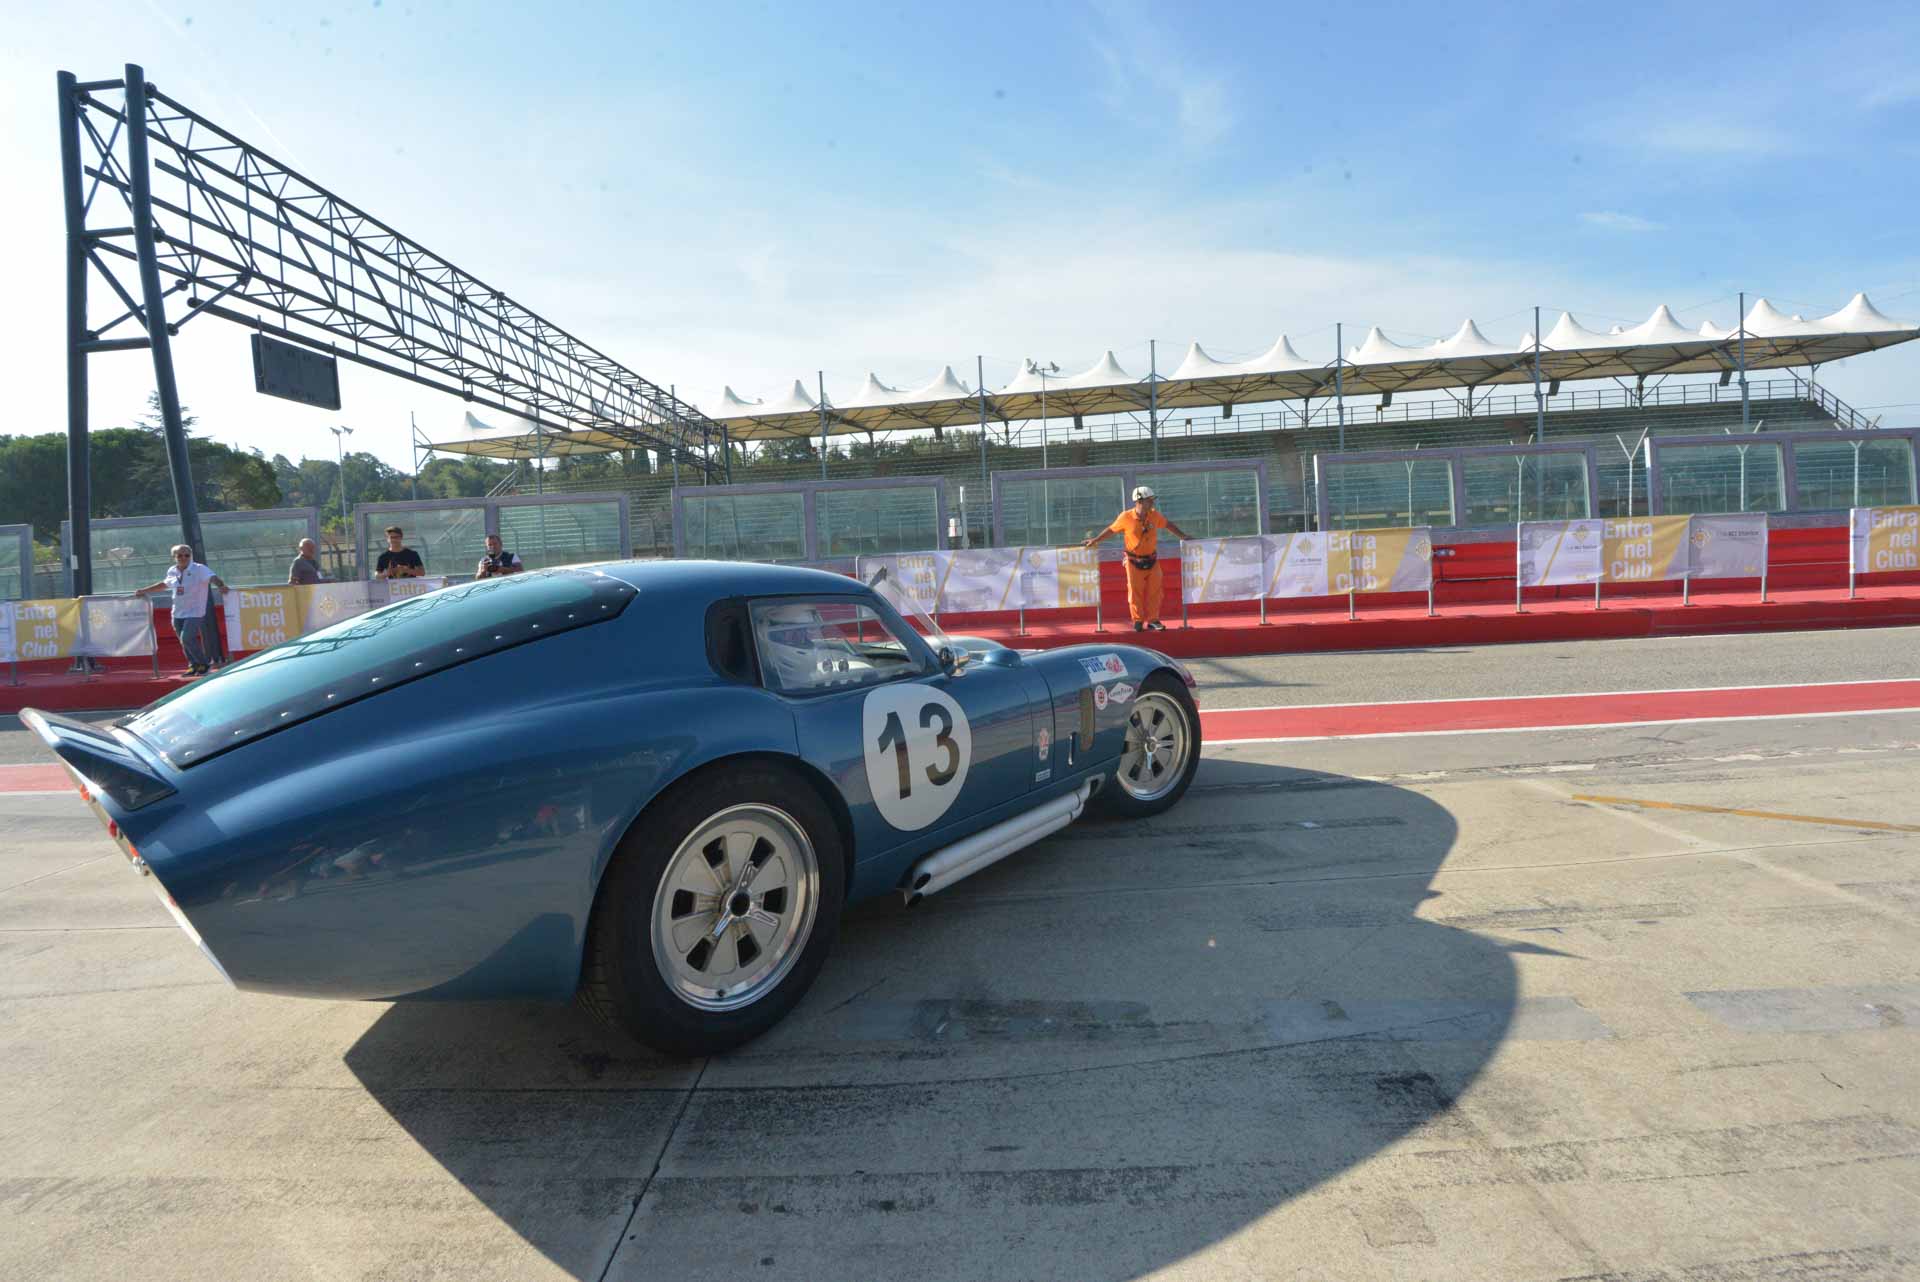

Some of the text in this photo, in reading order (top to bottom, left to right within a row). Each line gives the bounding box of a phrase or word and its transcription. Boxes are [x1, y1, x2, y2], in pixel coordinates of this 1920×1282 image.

[1872, 510, 1918, 528] Entra
[1604, 520, 1652, 538] Entra
[1890, 527, 1918, 548] nel
[1328, 532, 1376, 552] Entra
[1624, 539, 1652, 560] nel
[1351, 551, 1377, 571] nel
[1876, 548, 1918, 569] Club
[1080, 569, 1100, 584] ne
[1611, 559, 1653, 580] Club
[390, 582, 427, 596] Entra
[1336, 572, 1377, 592] Club
[240, 591, 283, 608] Entra
[15, 603, 57, 620] Entra
[260, 608, 285, 627] nel
[34, 620, 58, 639] nel
[248, 629, 286, 647] Club
[22, 640, 58, 657] Club
[878, 702, 960, 800] 13
